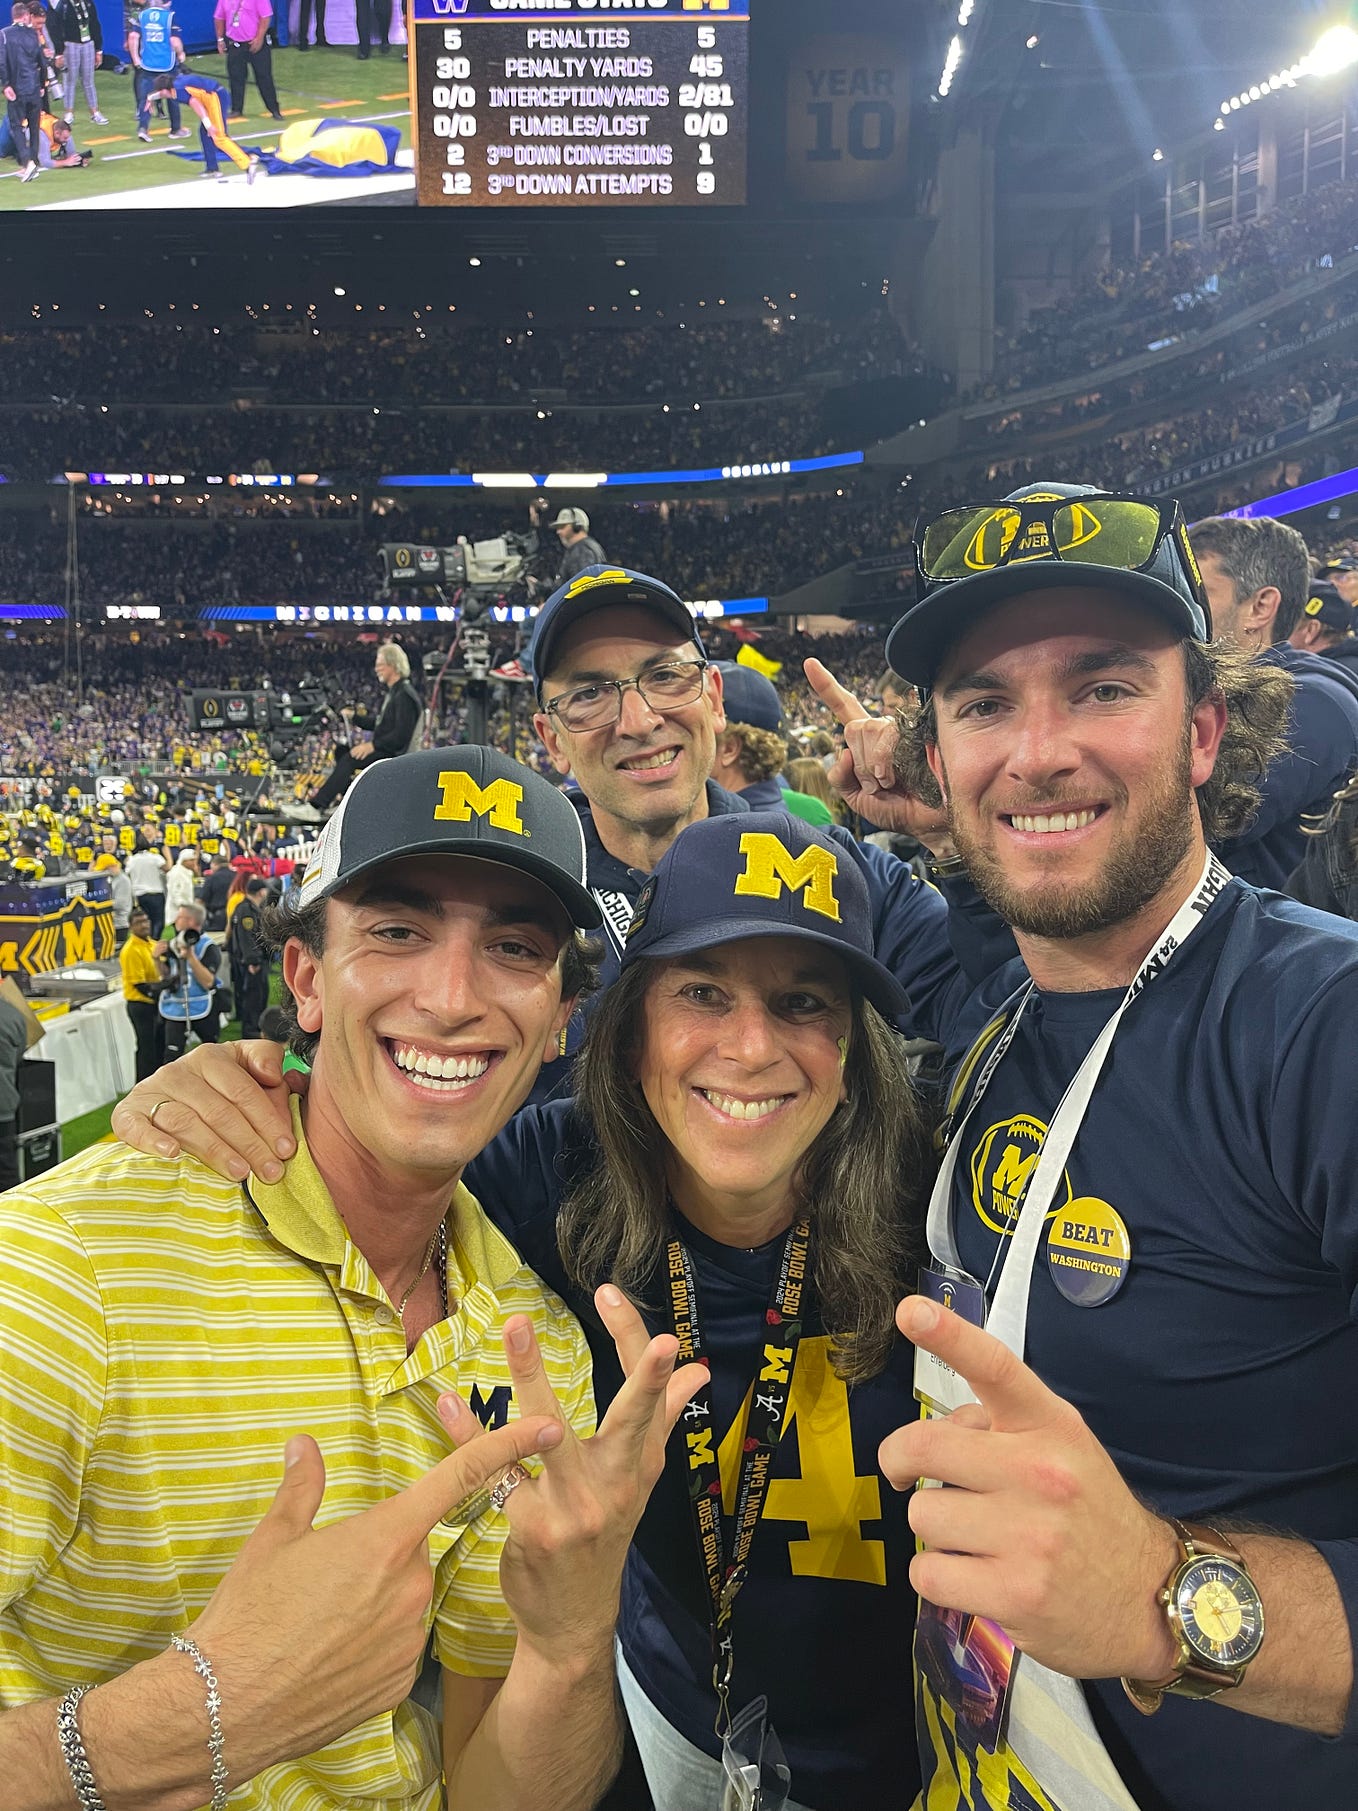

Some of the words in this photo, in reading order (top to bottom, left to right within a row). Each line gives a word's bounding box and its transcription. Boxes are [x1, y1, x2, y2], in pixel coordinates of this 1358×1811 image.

[444, 27, 462, 50] 5
[527, 28, 630, 49] PENALTIES
[697, 25, 716, 48] 5
[436, 57, 471, 79] 30
[505, 57, 587, 78] PENALTY
[590, 56, 653, 78] YARDS
[689, 54, 723, 77] 45
[488, 85, 670, 108] INTERCEPTION/YARDS
[678, 82, 735, 109] 2/81
[806, 69, 895, 97] YEAR
[432, 84, 476, 110] 0/0
[433, 113, 477, 138] 0/0
[509, 114, 650, 138] FUMBLES/LOST
[684, 111, 729, 138] 0/0
[806, 101, 896, 161] 10
[447, 143, 465, 166] 2
[514, 144, 562, 166] DOWN
[563, 144, 673, 166] CONVERSIONS
[698, 143, 714, 166] 1
[441, 172, 472, 195] 12
[516, 174, 571, 195] DOWN
[575, 173, 673, 195] ATTEMPTS
[696, 171, 715, 195] 9
[275, 605, 422, 621] MICHIGAN
[433, 771, 523, 835] M
[734, 832, 843, 923] M
[63, 920, 96, 967] M
[1061, 1221, 1115, 1248] BEAT
[667, 1241, 685, 1278] ROSE
[788, 1241, 808, 1279] BOWL
[1049, 1251, 1122, 1279] WASHINGTON
[670, 1280, 690, 1320] BOWL
[782, 1280, 803, 1315] ROSE
[675, 1322, 695, 1361] GAME
[760, 1343, 793, 1385] M
[686, 1427, 715, 1470] M
[751, 1452, 771, 1488] GAME
[697, 1498, 713, 1534] ROSE
[743, 1490, 763, 1531] BOWL
[702, 1534, 719, 1575] BOWL
[737, 1528, 754, 1563] ROSE
